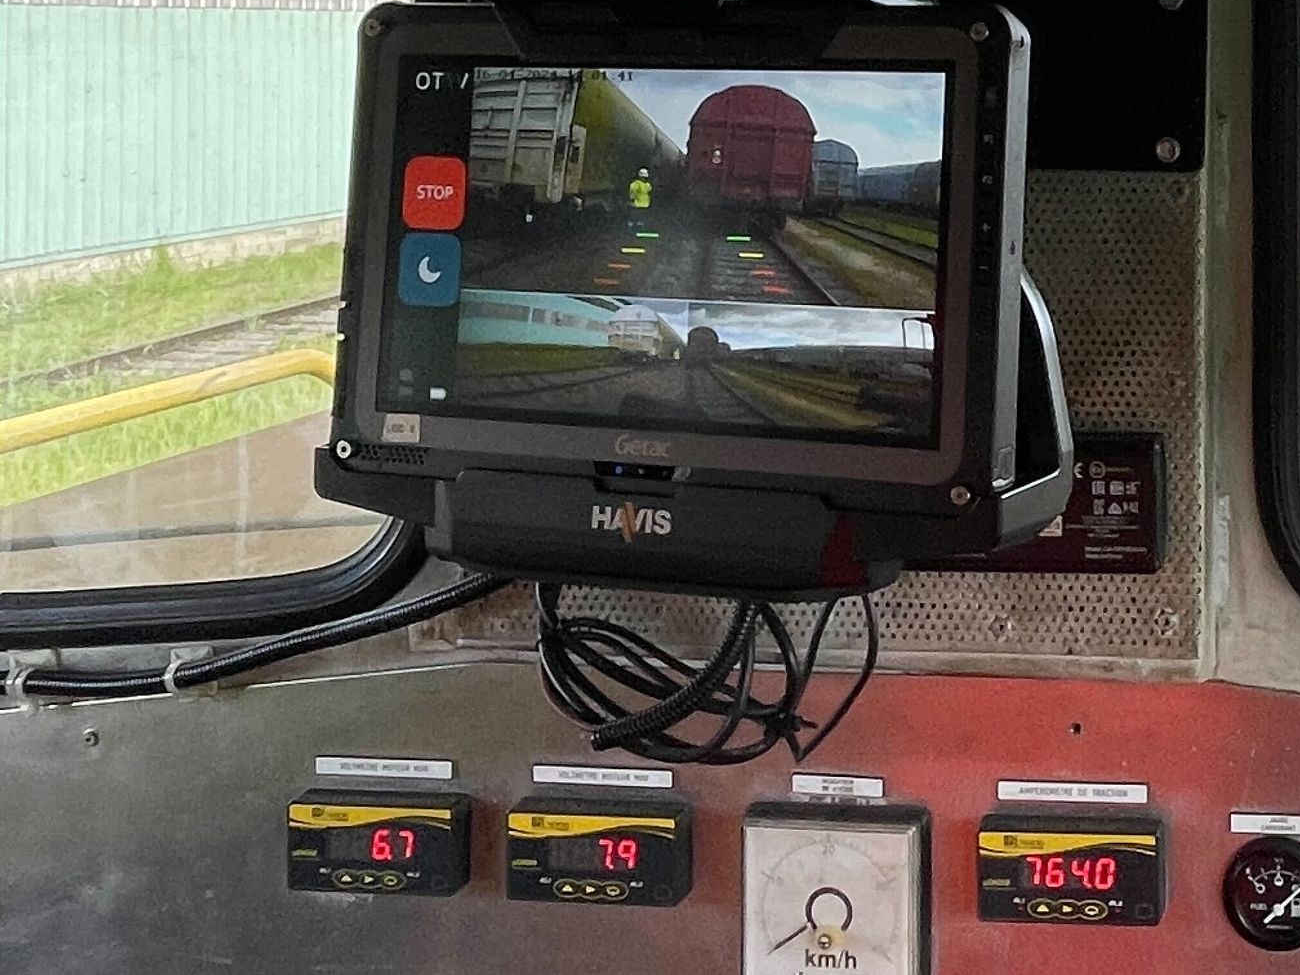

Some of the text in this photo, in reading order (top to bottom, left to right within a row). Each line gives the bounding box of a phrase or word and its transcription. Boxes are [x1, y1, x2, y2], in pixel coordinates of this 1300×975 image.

[416, 184, 454, 200] STOP
[591, 502, 672, 539] HAVIS
[804, 948, 857, 969] km/h
